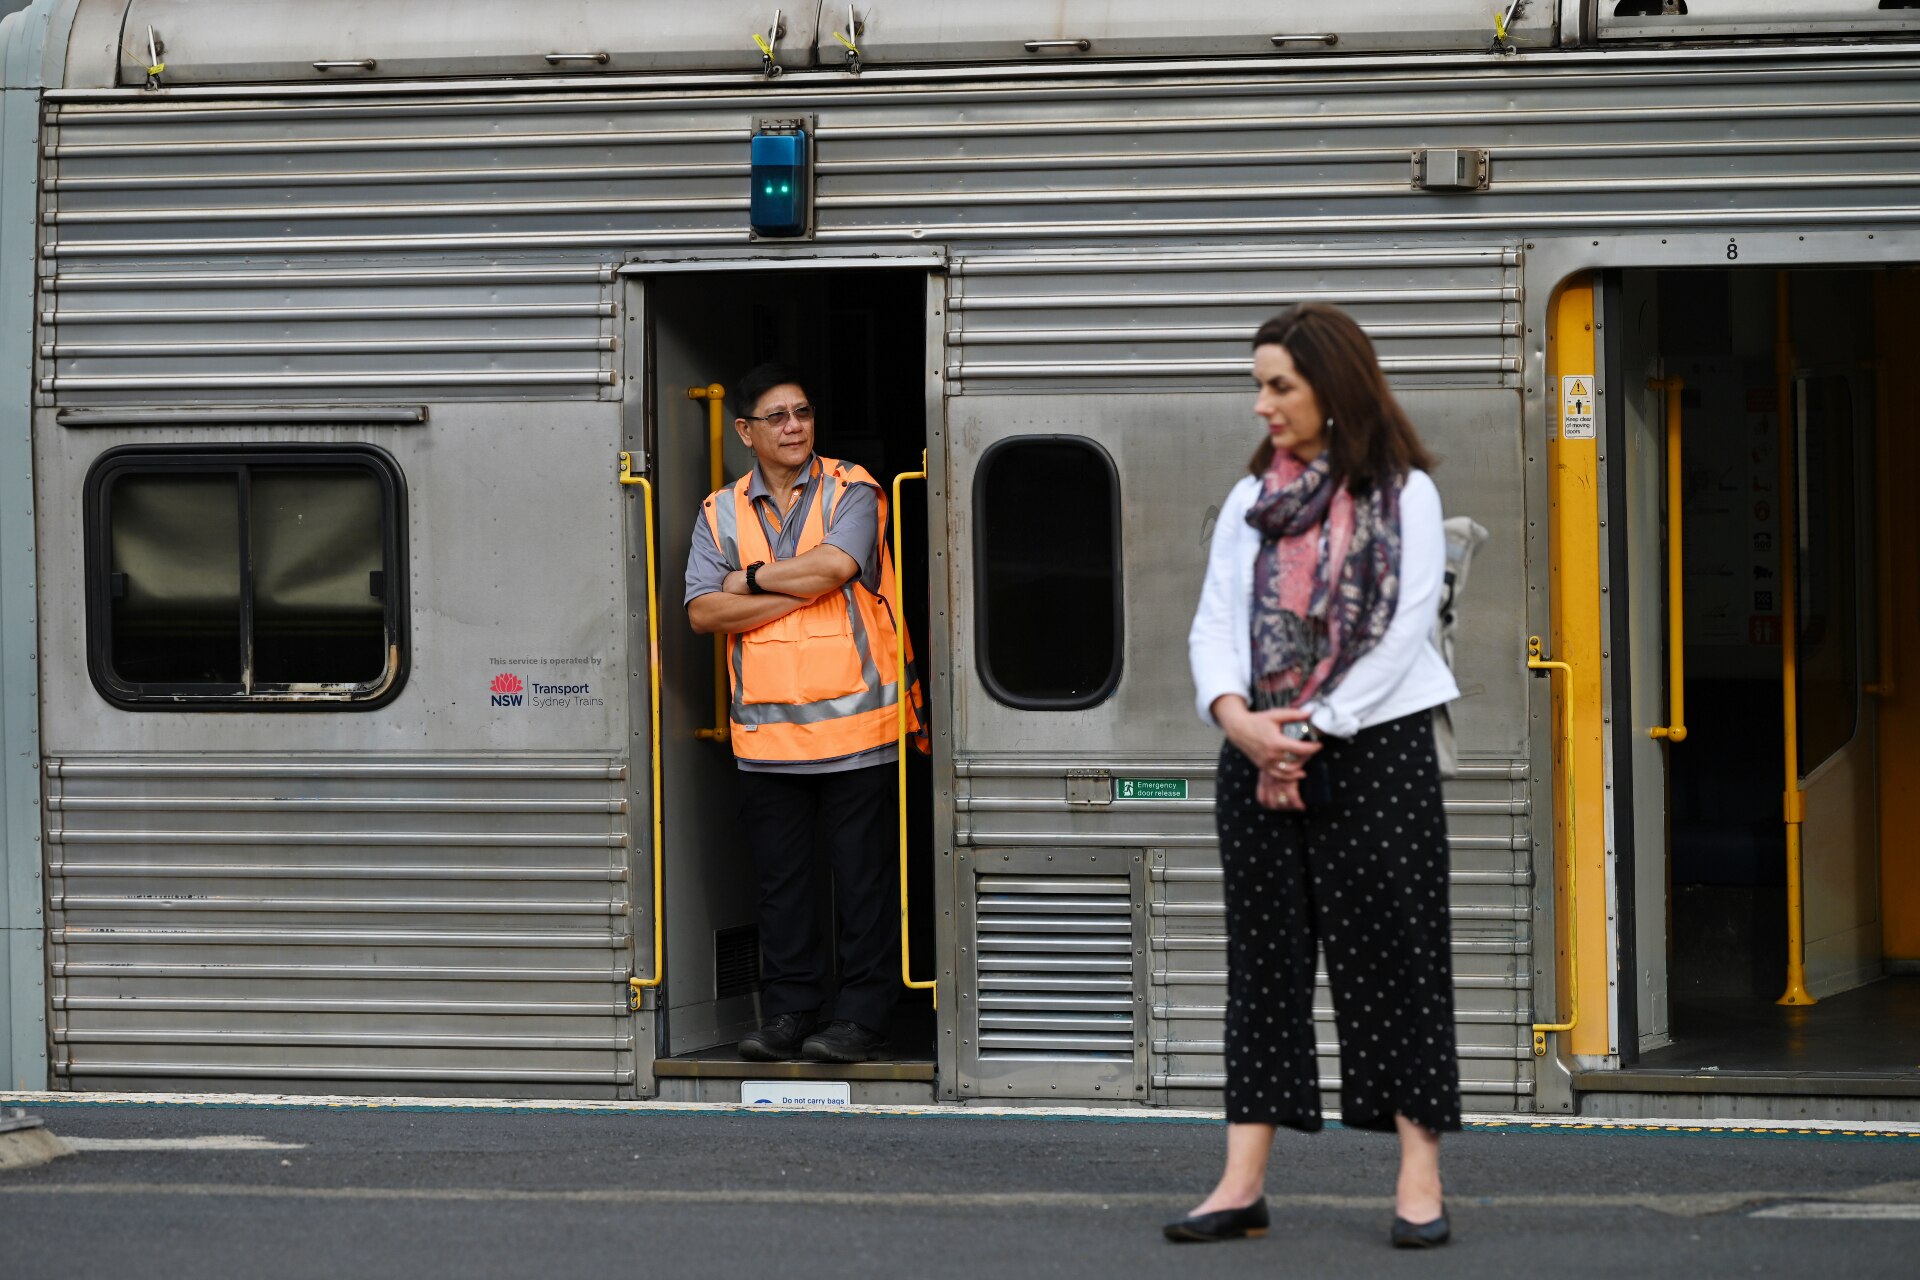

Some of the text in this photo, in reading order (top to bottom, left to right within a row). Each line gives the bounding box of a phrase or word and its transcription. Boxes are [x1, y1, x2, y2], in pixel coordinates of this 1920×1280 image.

[1726, 243, 1738, 260] 8
[490, 656, 602, 667] This service is operated by
[532, 683, 590, 695] Transport
[491, 694, 523, 707] NSW
[532, 696, 604, 708] Sydney Trains
[1137, 781, 1177, 790] Emergency
[827, 1097, 845, 1105] bags
